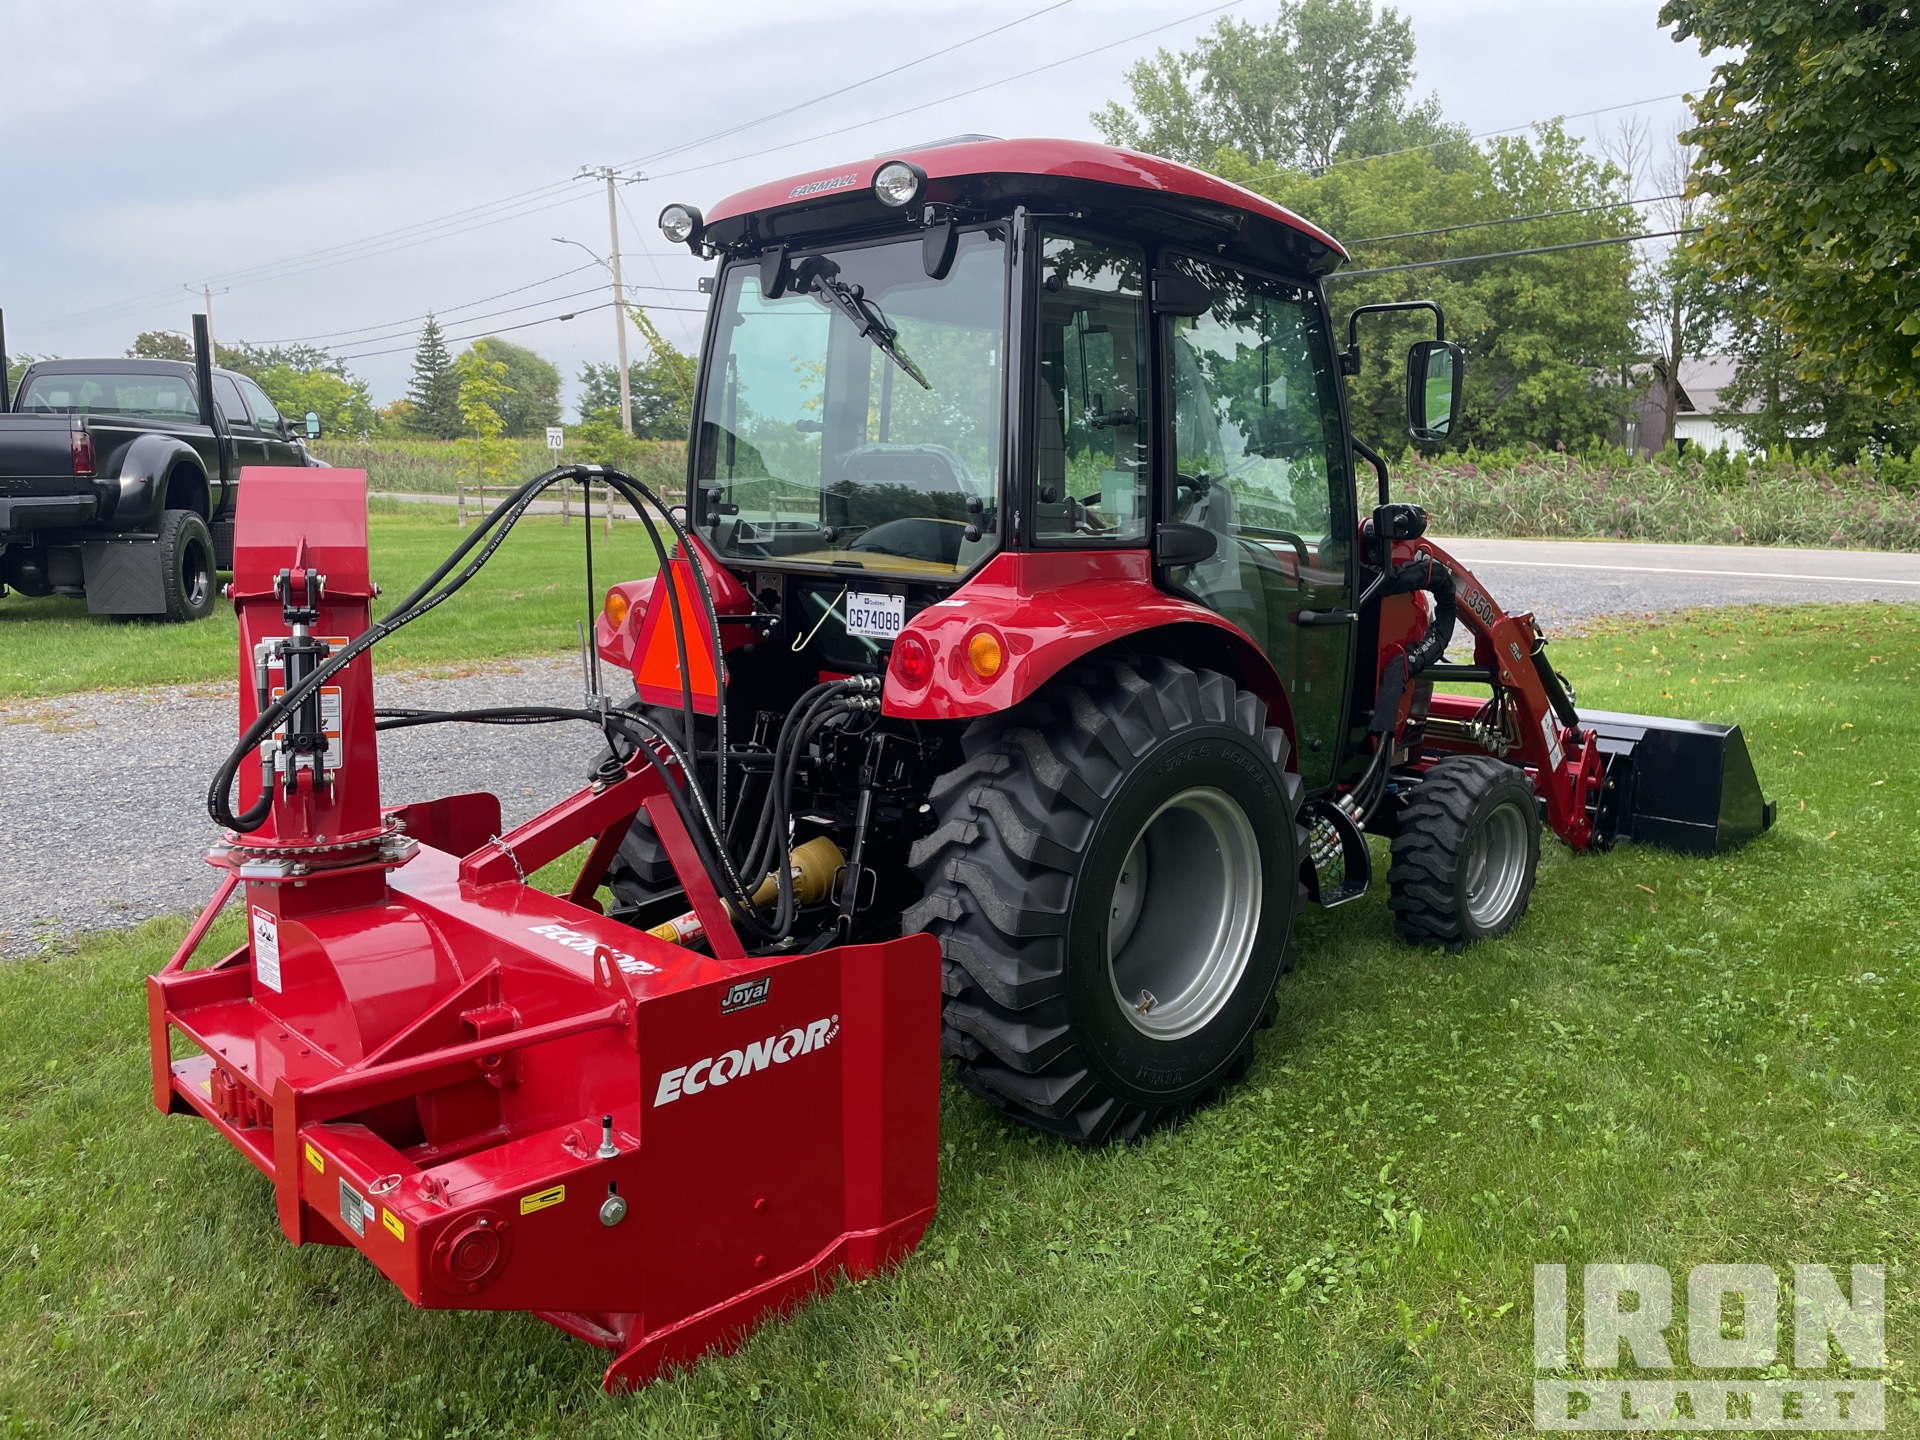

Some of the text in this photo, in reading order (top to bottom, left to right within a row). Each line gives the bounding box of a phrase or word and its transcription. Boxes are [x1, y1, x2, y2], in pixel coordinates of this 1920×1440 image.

[788, 173, 858, 199] FARMALL
[549, 435, 561, 446] 70
[849, 608, 899, 630] C674088
[1463, 585, 1495, 630] L350A
[722, 977, 770, 1006] Joyal
[653, 1018, 831, 1108] ECONOR
